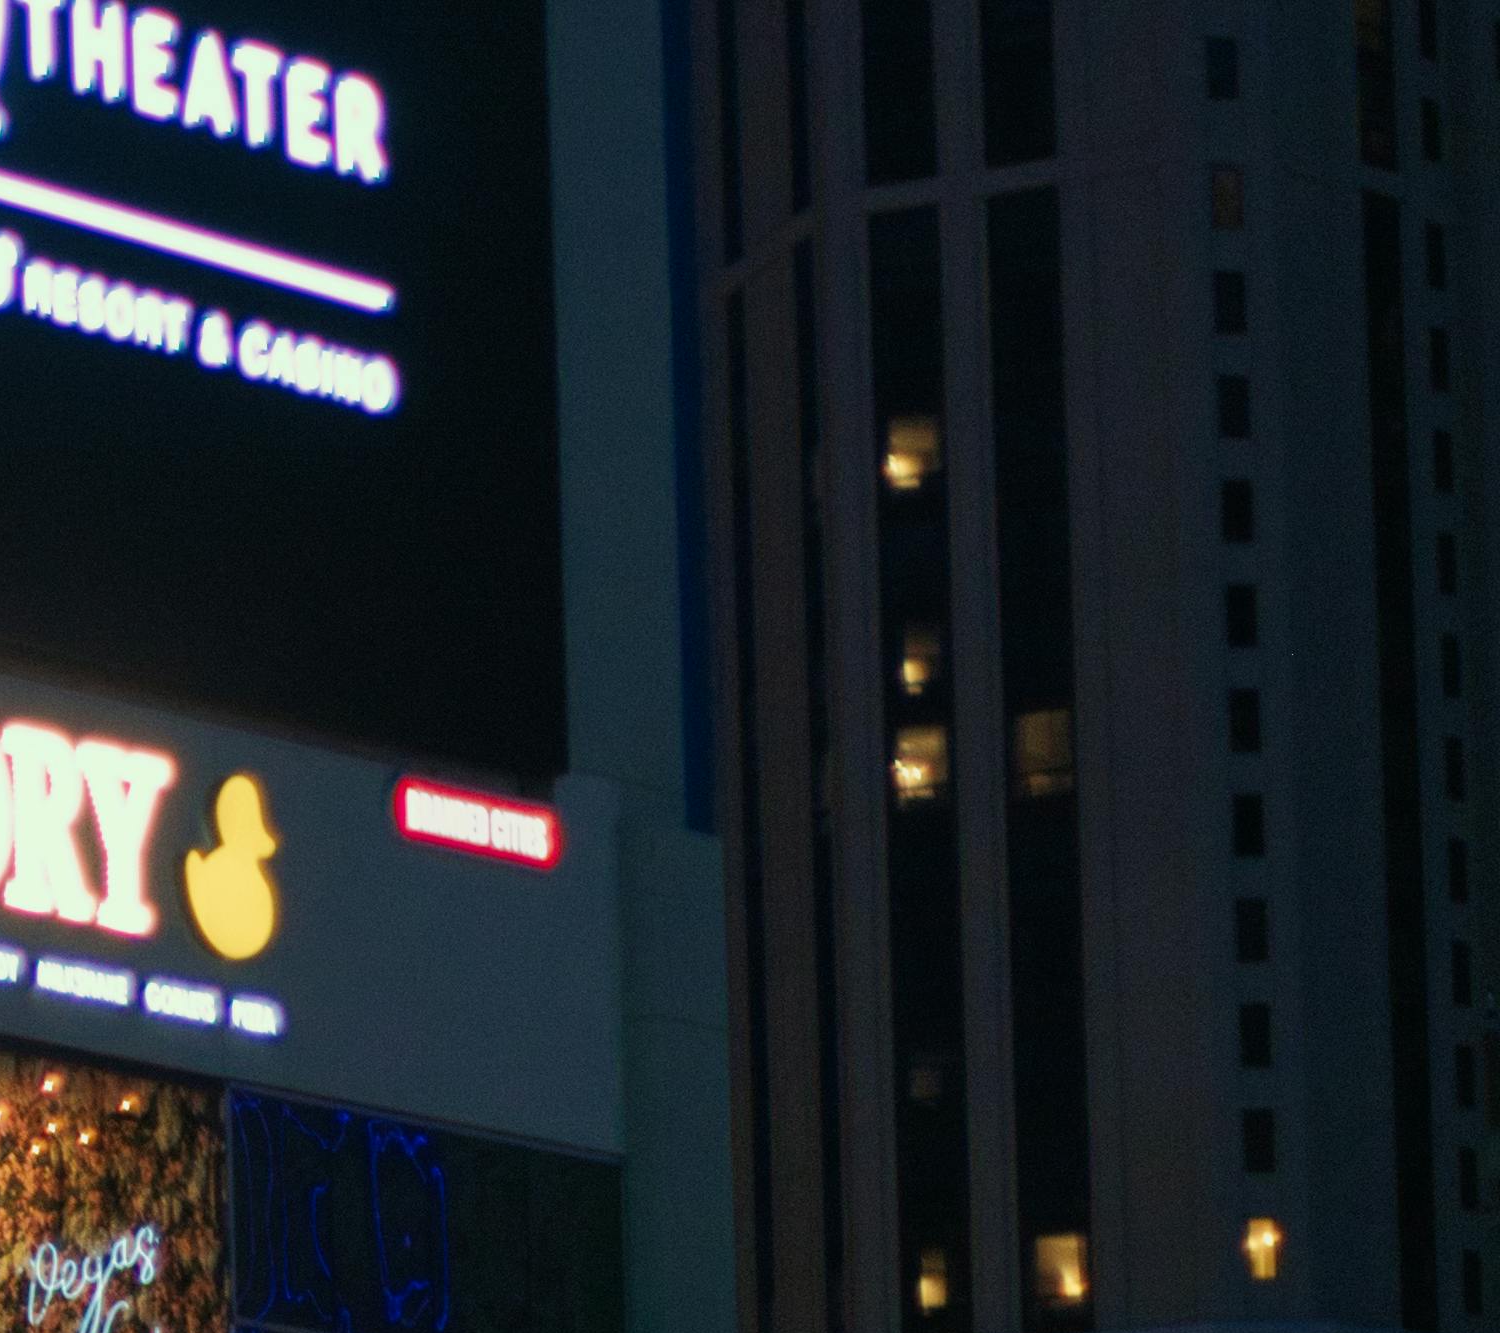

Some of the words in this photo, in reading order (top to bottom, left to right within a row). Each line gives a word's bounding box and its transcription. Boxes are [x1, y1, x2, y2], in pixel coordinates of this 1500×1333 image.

[15, 0, 388, 184] THEATER
[23, 259, 187, 353] RESORT
[199, 311, 232, 368] &
